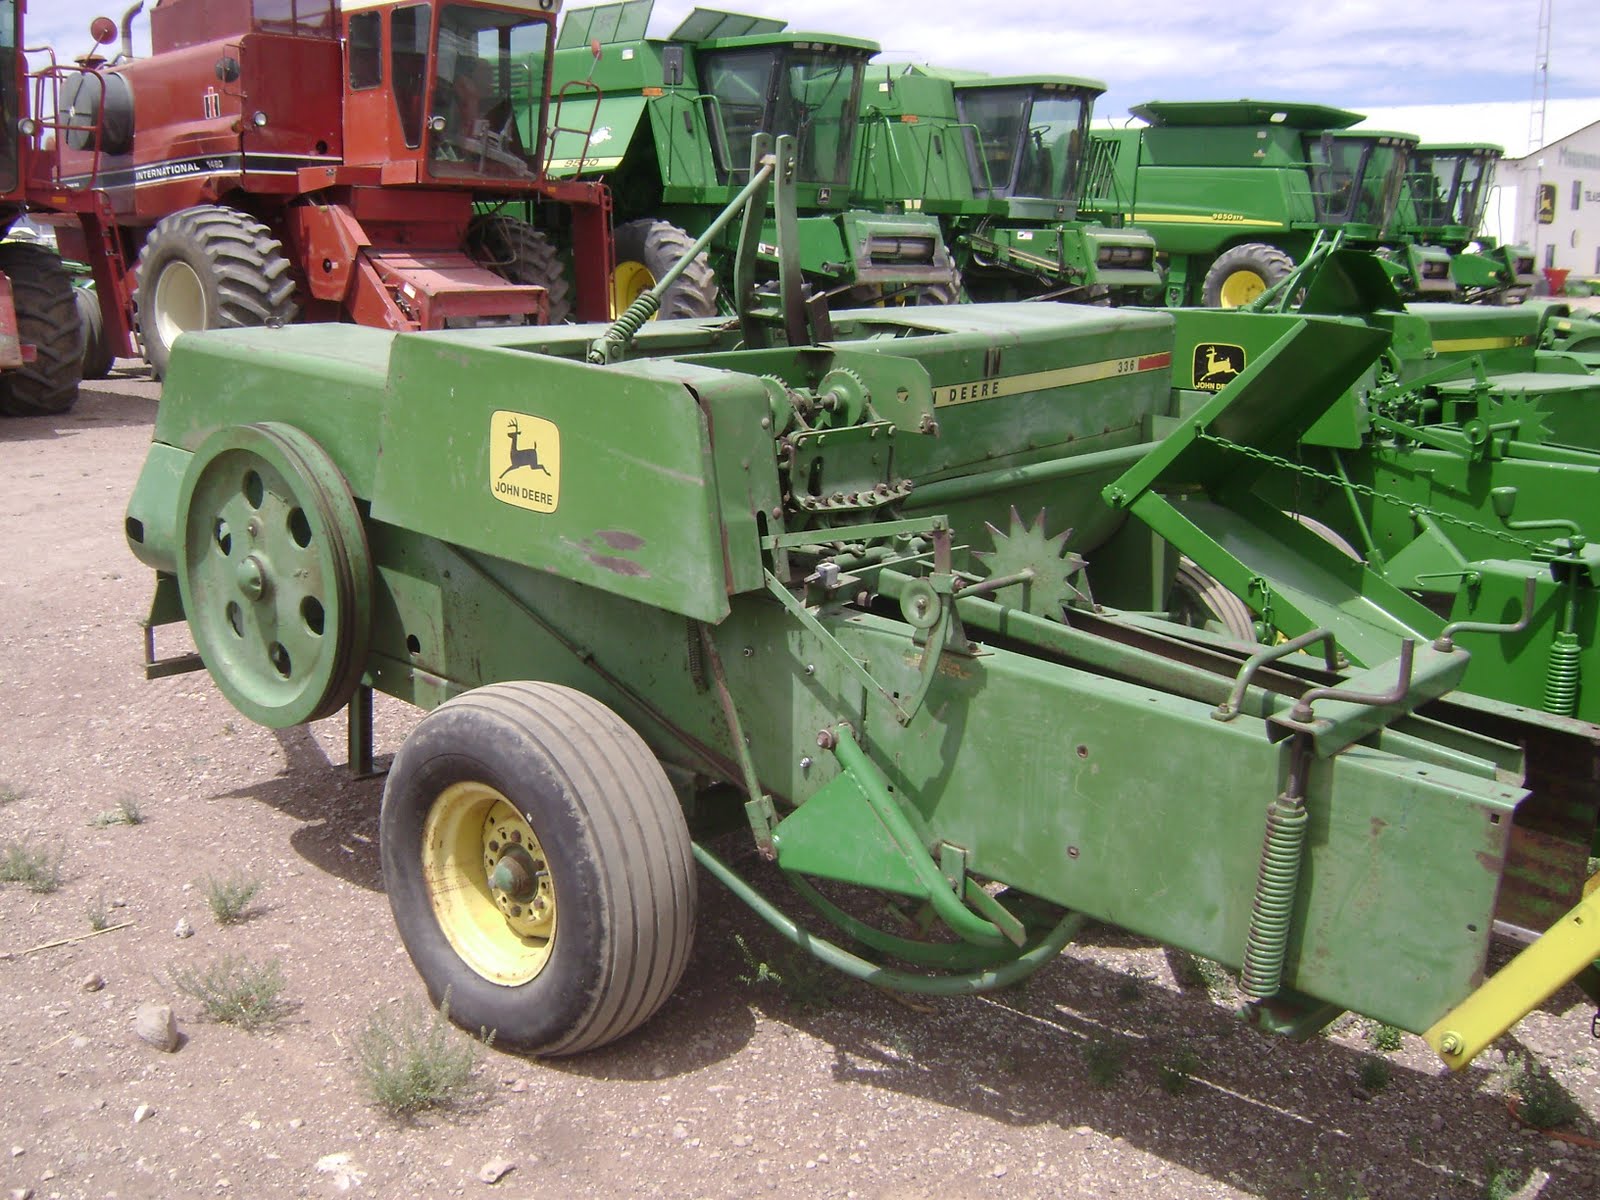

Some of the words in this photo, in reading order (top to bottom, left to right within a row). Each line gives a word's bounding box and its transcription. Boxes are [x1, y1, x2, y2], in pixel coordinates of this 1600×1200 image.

[135, 162, 200, 180] INTERNATIONAL
[1117, 359, 1135, 373] 336
[949, 381, 999, 402] DEERE
[1195, 381, 1215, 390] JOHN
[494, 481, 520, 497] JOHN
[521, 487, 553, 506] DEERE
